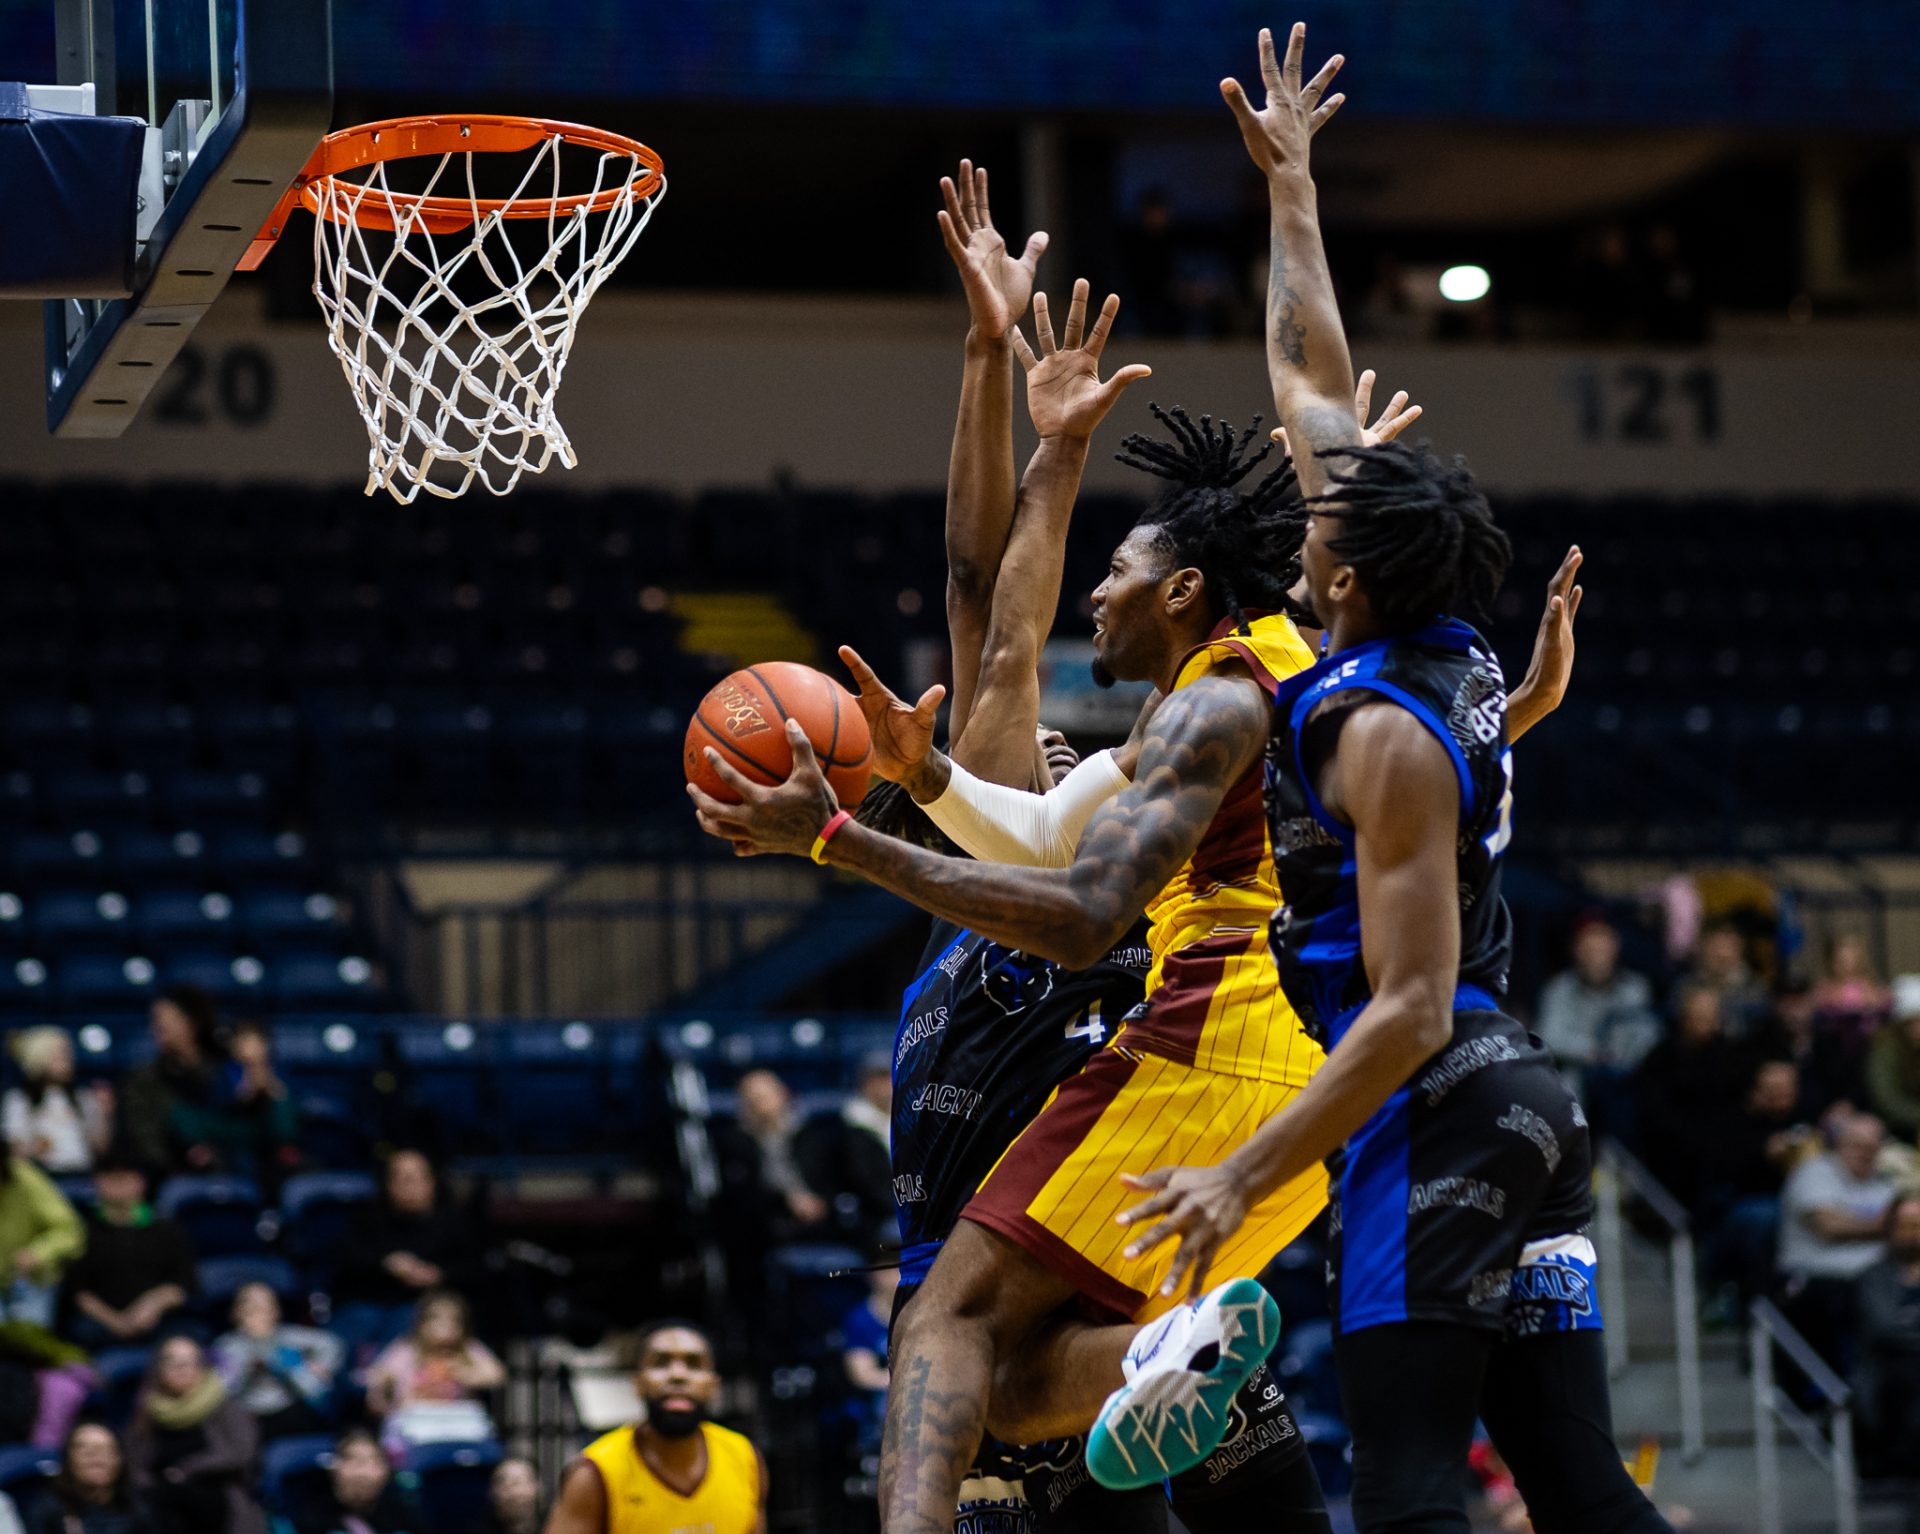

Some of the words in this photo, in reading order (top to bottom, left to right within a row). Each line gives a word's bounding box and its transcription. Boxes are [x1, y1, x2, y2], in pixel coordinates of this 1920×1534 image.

[896, 1006, 949, 1070] CKALS
[1064, 999, 1105, 1044] 4
[1420, 1034, 1520, 1107] JACKALS
[1205, 1414, 1296, 1484] JACKALS
